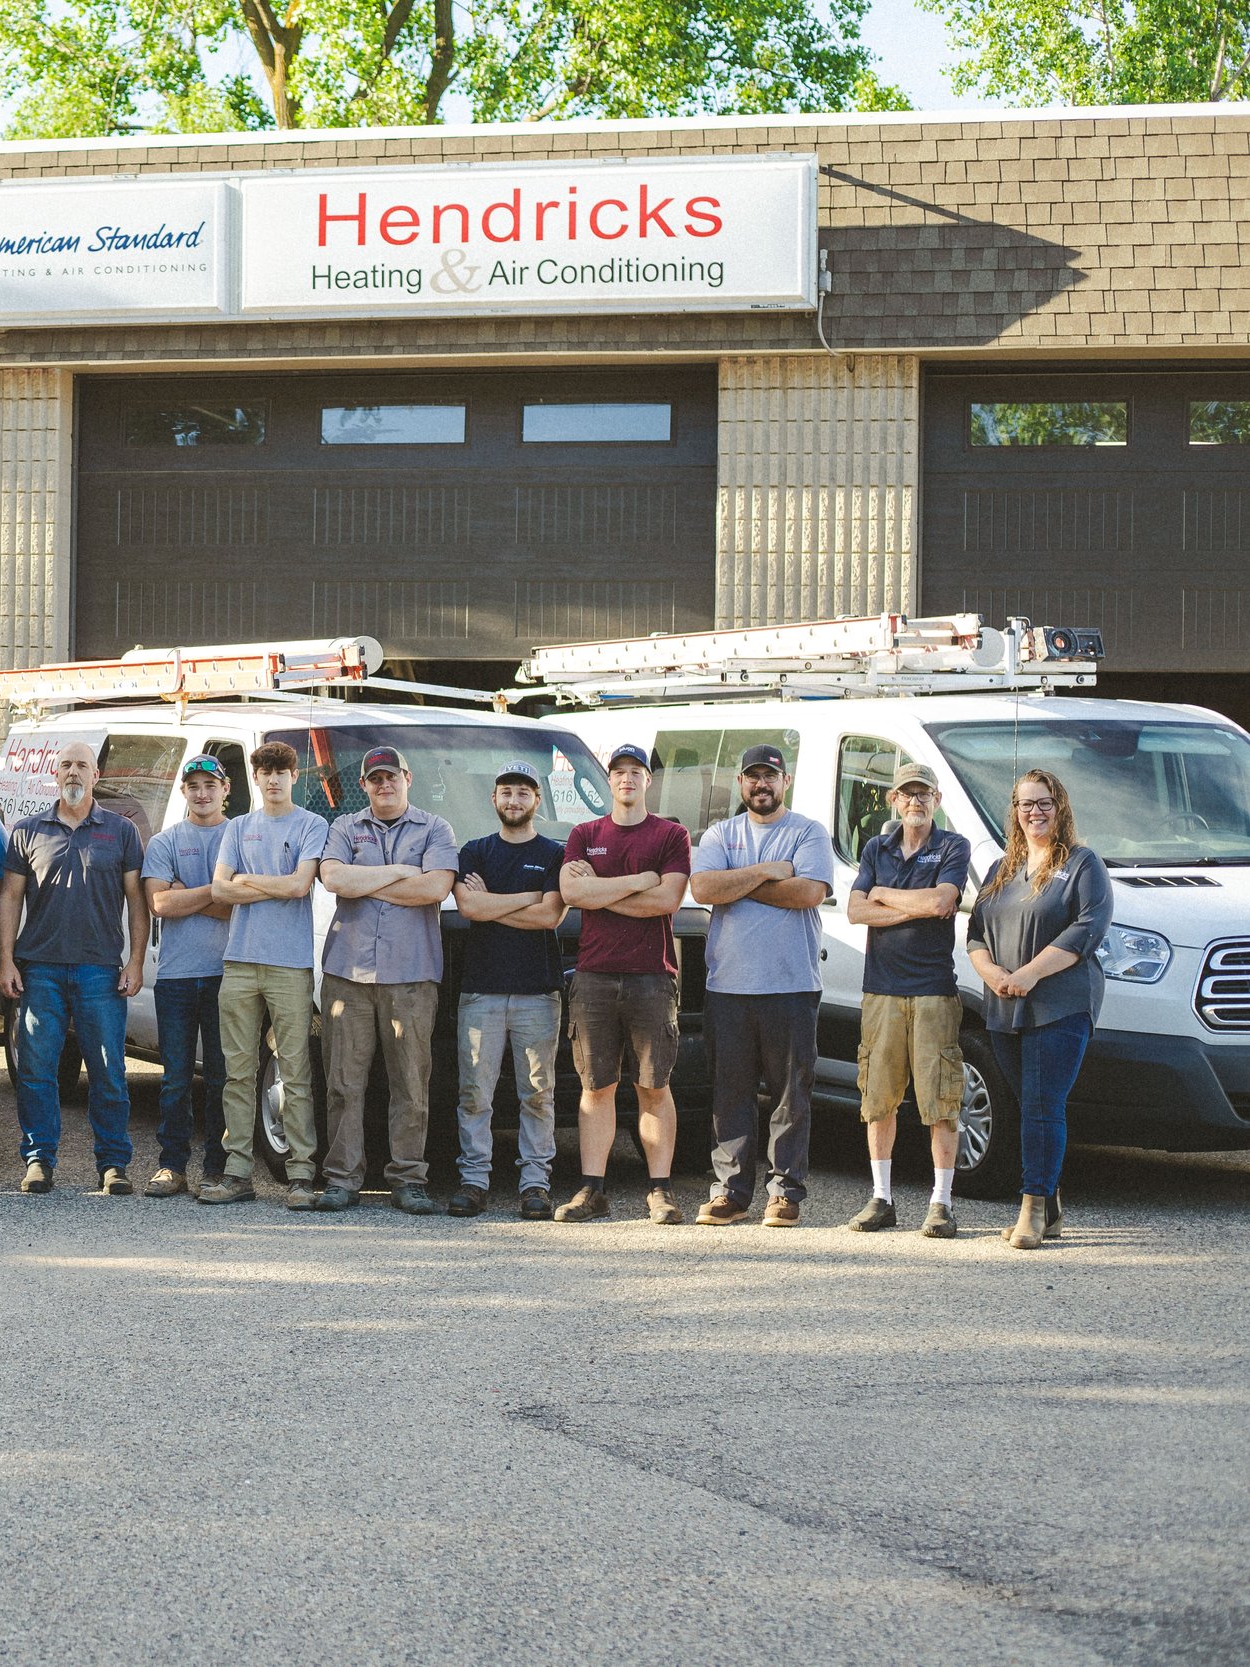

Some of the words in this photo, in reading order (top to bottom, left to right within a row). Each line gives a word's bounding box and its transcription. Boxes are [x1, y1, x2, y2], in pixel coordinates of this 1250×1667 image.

[317, 184, 723, 247] Hendricks
[87, 221, 206, 252] Standard
[45, 268, 52, 276] &
[62, 267, 85, 275] AIR
[94, 263, 208, 275] CONDITIONING
[312, 262, 422, 294] Heating
[429, 248, 482, 295] &
[488, 260, 529, 286] Air
[536, 256, 724, 288] Conditioning
[4, 739, 60, 776] Hendric
[17, 799, 51, 817] 452-60
[552, 789, 577, 806] 616)
